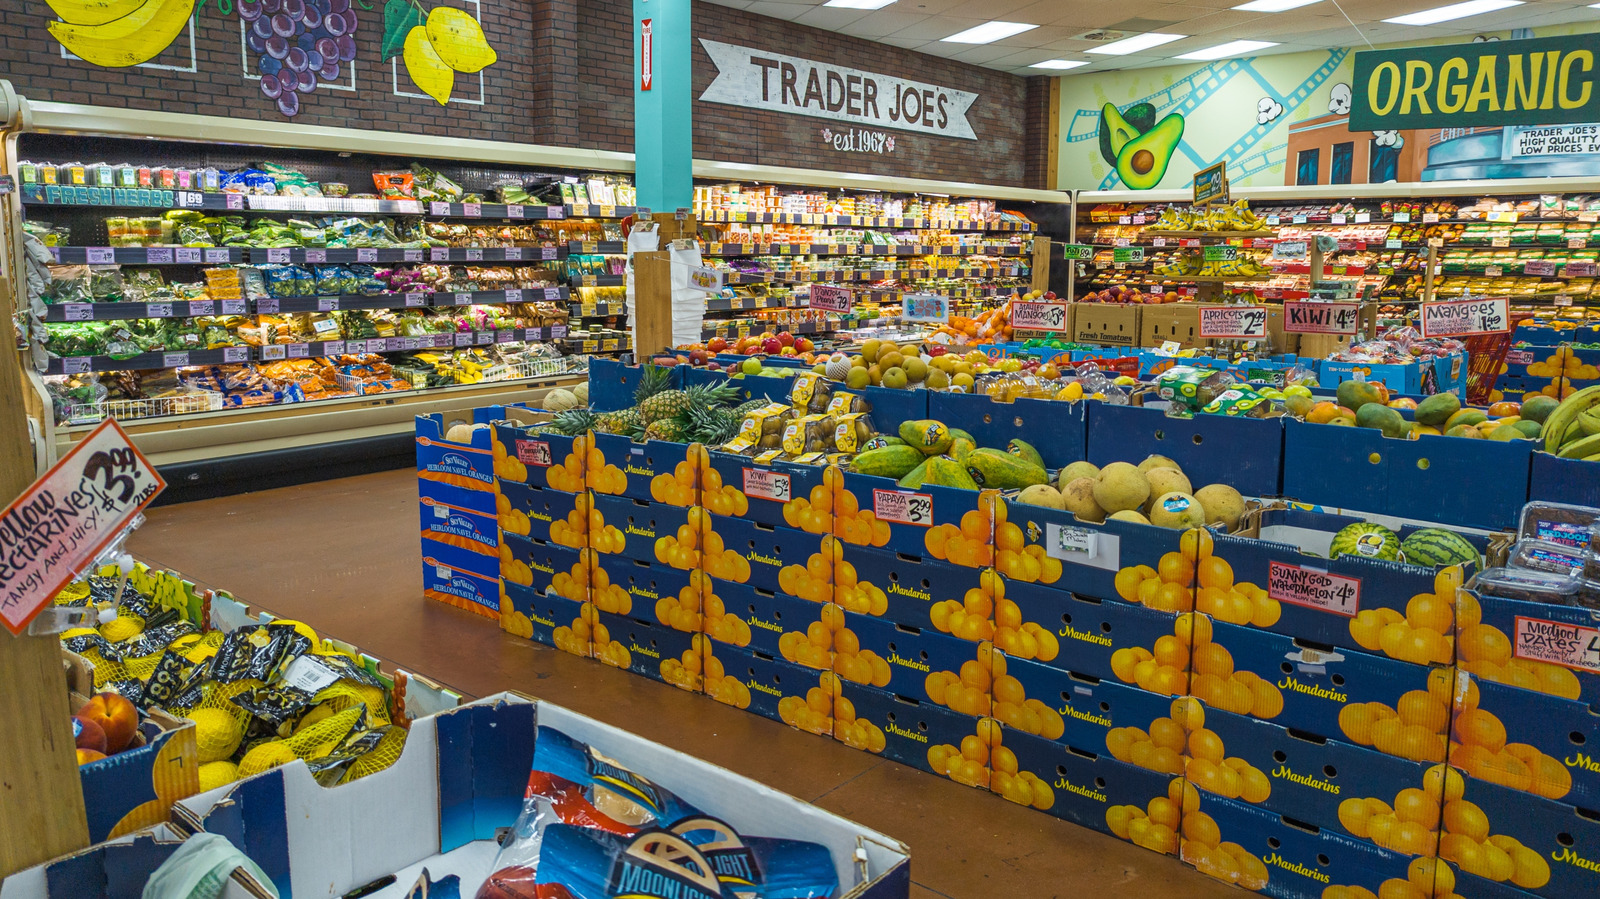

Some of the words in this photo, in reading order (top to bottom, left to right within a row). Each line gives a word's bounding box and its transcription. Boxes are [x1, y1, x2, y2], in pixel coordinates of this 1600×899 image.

[1368, 50, 1594, 116] ORGANIC
[750, 56, 880, 118] TRADER
[889, 86, 948, 129] JOE'S
[1520, 136, 1546, 147] HIGH
[1548, 135, 1598, 144] QUALITY
[1523, 128, 1562, 138] TRADER
[1568, 126, 1597, 134] JOE'S
[1521, 146, 1544, 155] LOW
[1548, 144, 1583, 153] PRICES
[46, 186, 112, 204] FRESH
[114, 188, 174, 208] HERBS
[1204, 310, 1245, 320] APRICOTS
[1290, 308, 1331, 325] KIWI
[1080, 331, 1098, 339] Fresh
[1100, 333, 1132, 341] Tomatoes
[427, 464, 452, 472] HEIRLOOM
[452, 466, 468, 476] NAVEL
[468, 469, 493, 483] ORANGES
[624, 464, 654, 477] Mandarins
[132, 483, 158, 506] 2LBS
[876, 492, 906, 504] PAPAYA
[0, 489, 56, 556] ellow
[527, 510, 552, 522] Mandarins
[430, 524, 456, 534] HEIRLOOM
[456, 528, 472, 538] NAVEL
[472, 532, 497, 547] ORANGES
[625, 524, 655, 538] Mandarins
[1539, 529, 1588, 542] MEDJOOL
[1550, 537, 1575, 546] DATES
[529, 561, 554, 574] Mandarins
[747, 552, 782, 567] Mandarins
[1272, 566, 1308, 584] SUNNY
[1309, 574, 1332, 586] GOLD
[433, 584, 458, 595] HEIRLOOM
[459, 590, 474, 600] NAVEL
[475, 595, 499, 611] ORANGES
[628, 586, 658, 600] Mandarins
[887, 582, 931, 601] Mandarins
[1270, 579, 1335, 600] WATERMELON
[530, 613, 555, 627] Mandarins
[748, 616, 782, 633] Mandarins
[1059, 625, 1112, 647] Mandarins
[1528, 622, 1581, 640] Medjool
[630, 642, 660, 658] Mandarins
[887, 654, 930, 673] Mandarins
[747, 680, 782, 697] Mandarins
[1278, 677, 1348, 703] Mandarins
[1059, 705, 1112, 728] Mandarins
[885, 723, 928, 743] Mandarins
[1272, 766, 1340, 795] Mandarins
[1054, 778, 1107, 802] Mandarins
[1263, 853, 1330, 884] Mandarins
